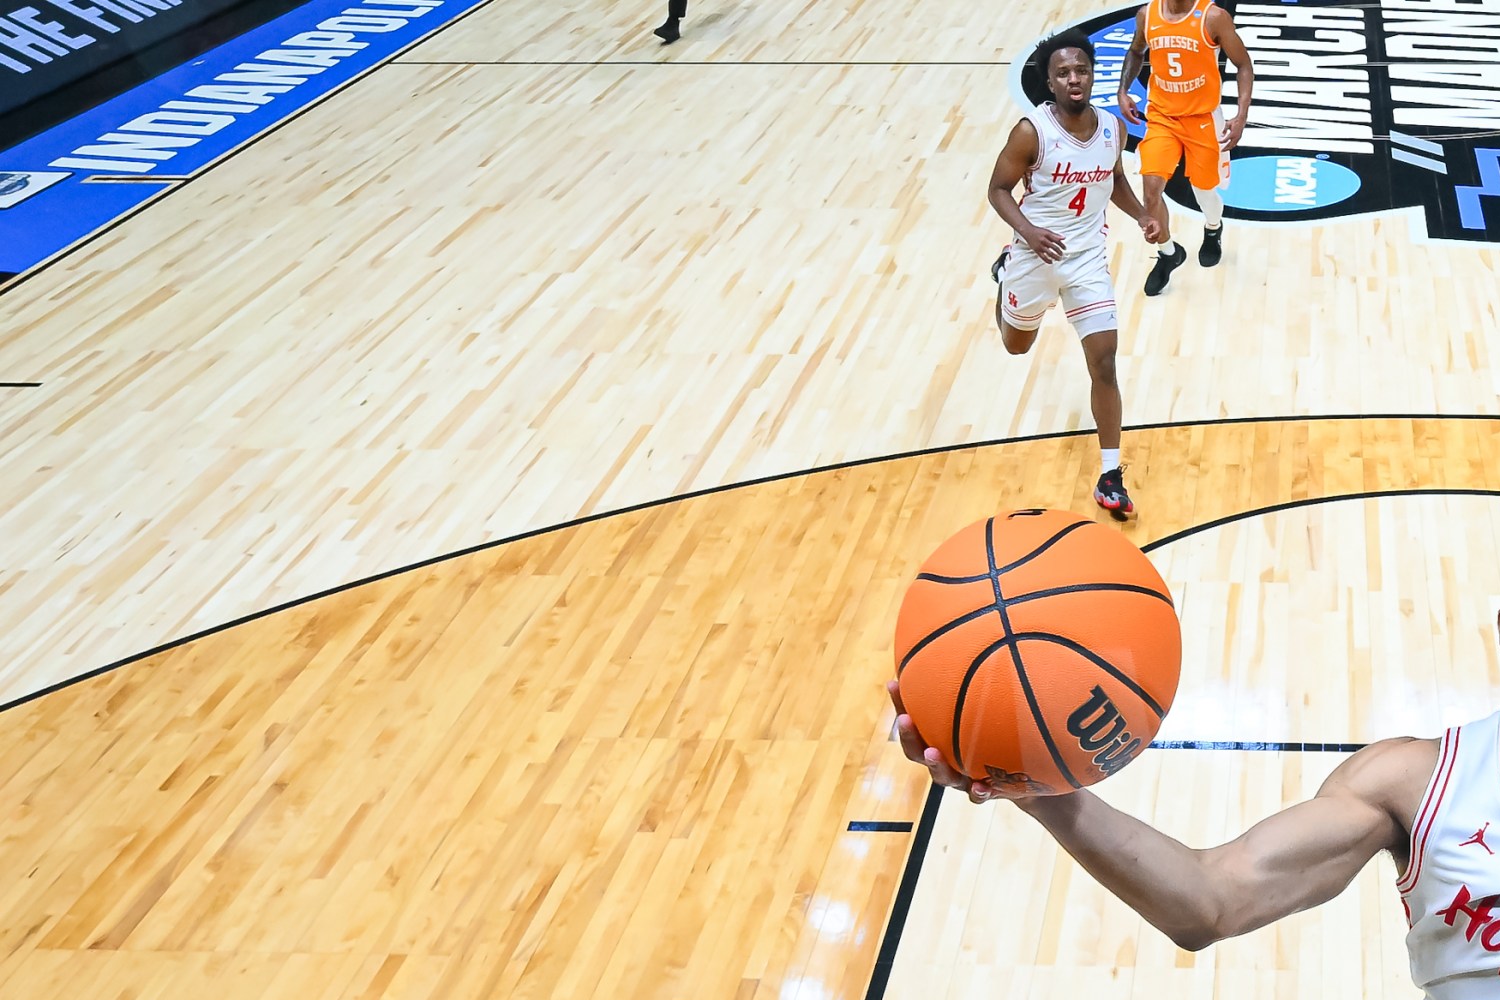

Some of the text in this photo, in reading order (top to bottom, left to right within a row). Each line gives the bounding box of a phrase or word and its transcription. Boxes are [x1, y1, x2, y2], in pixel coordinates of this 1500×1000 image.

[1151, 36, 1199, 53] TENNESSEE
[1167, 53, 1183, 77] 5
[1155, 74, 1206, 94] VOLUNTEERS
[1222, 3, 1374, 154] MARCH
[1051, 161, 1112, 185] Houston
[1274, 158, 1317, 206] NCAA
[1068, 187, 1087, 217] 4
